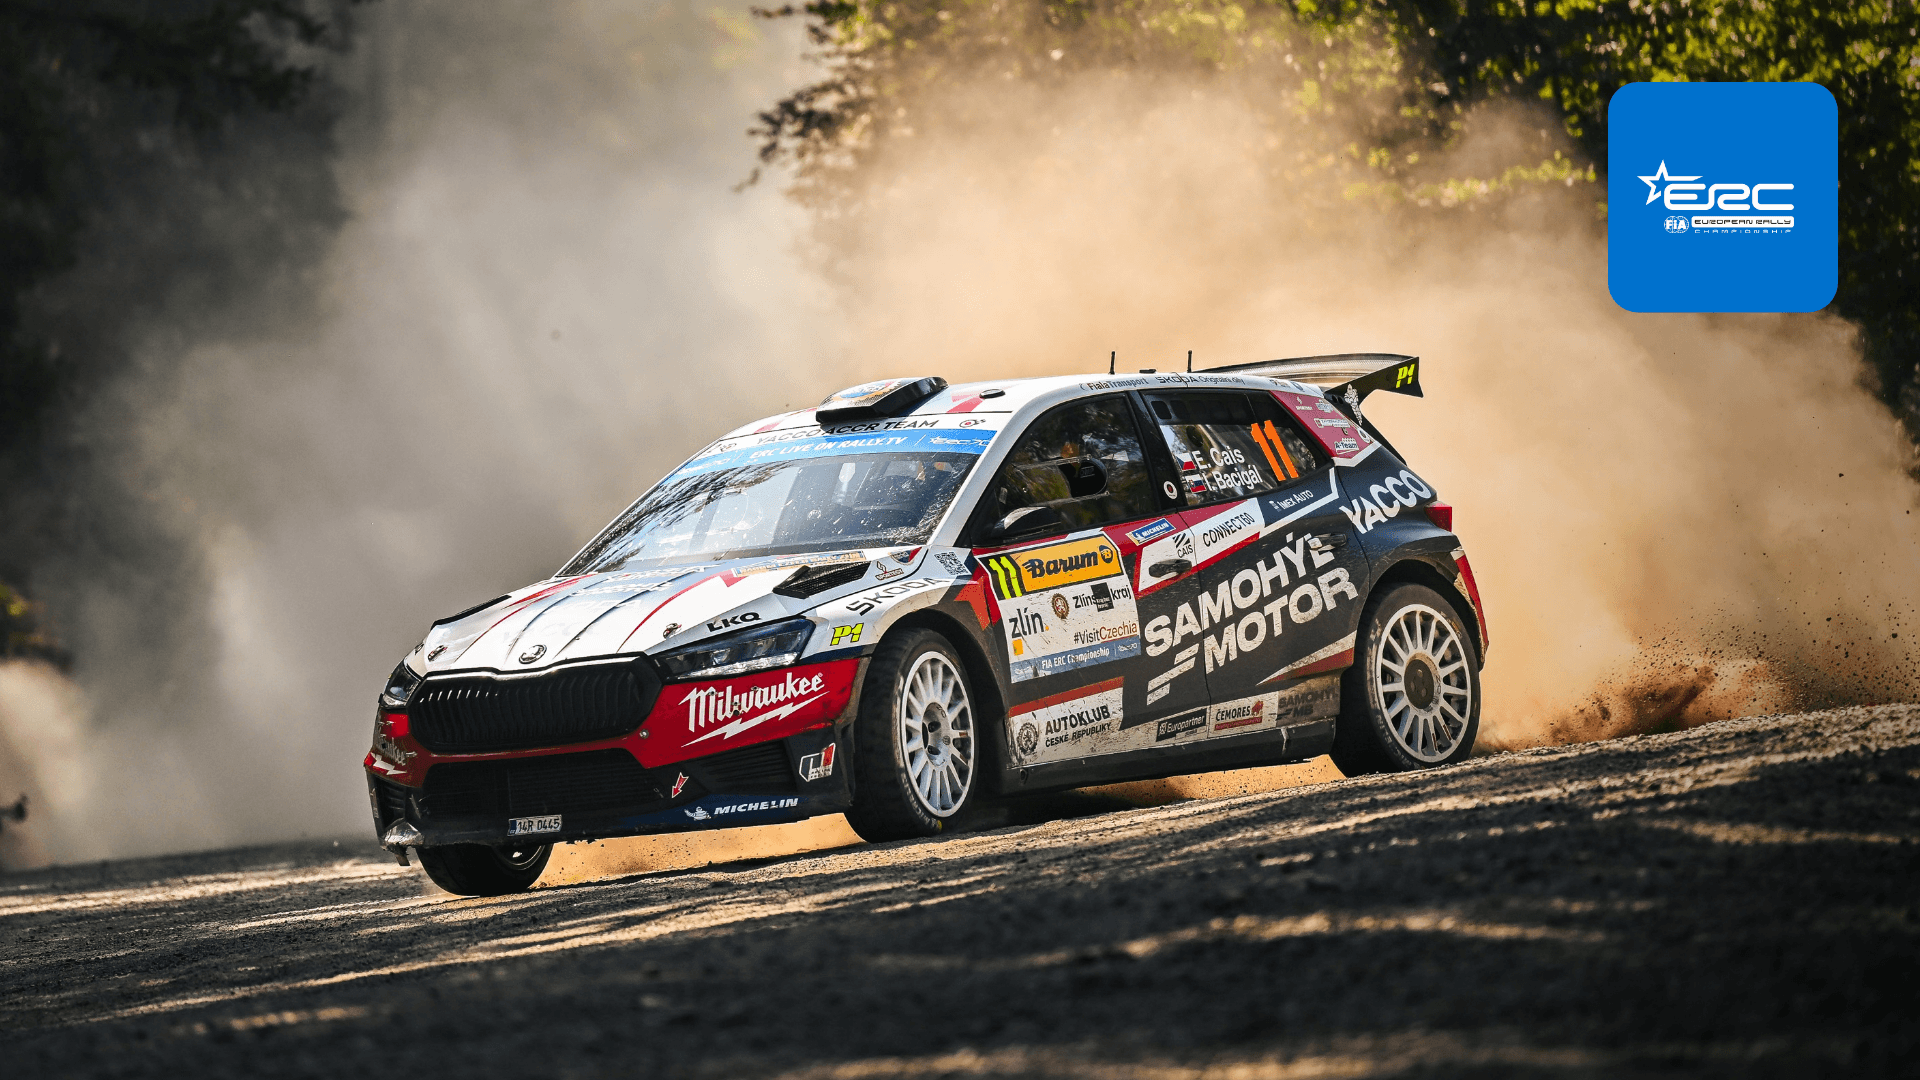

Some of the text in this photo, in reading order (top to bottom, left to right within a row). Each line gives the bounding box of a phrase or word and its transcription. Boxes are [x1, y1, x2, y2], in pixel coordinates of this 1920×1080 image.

[1395, 364, 1416, 388] P1
[821, 422, 881, 436] ACCR
[883, 419, 939, 430] TEAM
[749, 447, 780, 459] ERC
[780, 444, 814, 455] LIVE
[813, 441, 836, 451] ON
[836, 436, 909, 449] RALLY.TV
[1191, 445, 1245, 470] E. Cais
[1250, 419, 1299, 482] 11
[1212, 463, 1264, 490] Bacigál
[1338, 469, 1432, 535] YACCO
[1141, 522, 1170, 538] MICHELIN
[1202, 512, 1256, 548] CONNECT60
[1177, 544, 1194, 558] CAIS
[1022, 550, 1099, 579] Barum
[988, 556, 1023, 600] 11
[1110, 585, 1132, 601] kraj
[706, 611, 762, 633] LKQ
[1073, 620, 1138, 645] #VisitCzechia
[1202, 567, 1359, 675] MOTOR
[829, 622, 865, 647] P1
[1041, 659, 1053, 670] FIA
[1053, 656, 1066, 667] ERC
[1067, 646, 1110, 664] Championship
[677, 672, 826, 733] Milwaukee
[1215, 705, 1251, 722] ČEMORES
[1044, 705, 1111, 735] AUTOKLUB
[1166, 714, 1205, 734] Europartner
[1045, 722, 1112, 748] ČESKÉ REPUBLIKY
[713, 798, 799, 815] MICHELIN
[516, 820, 533, 833] 14R
[536, 818, 560, 831] 0445
